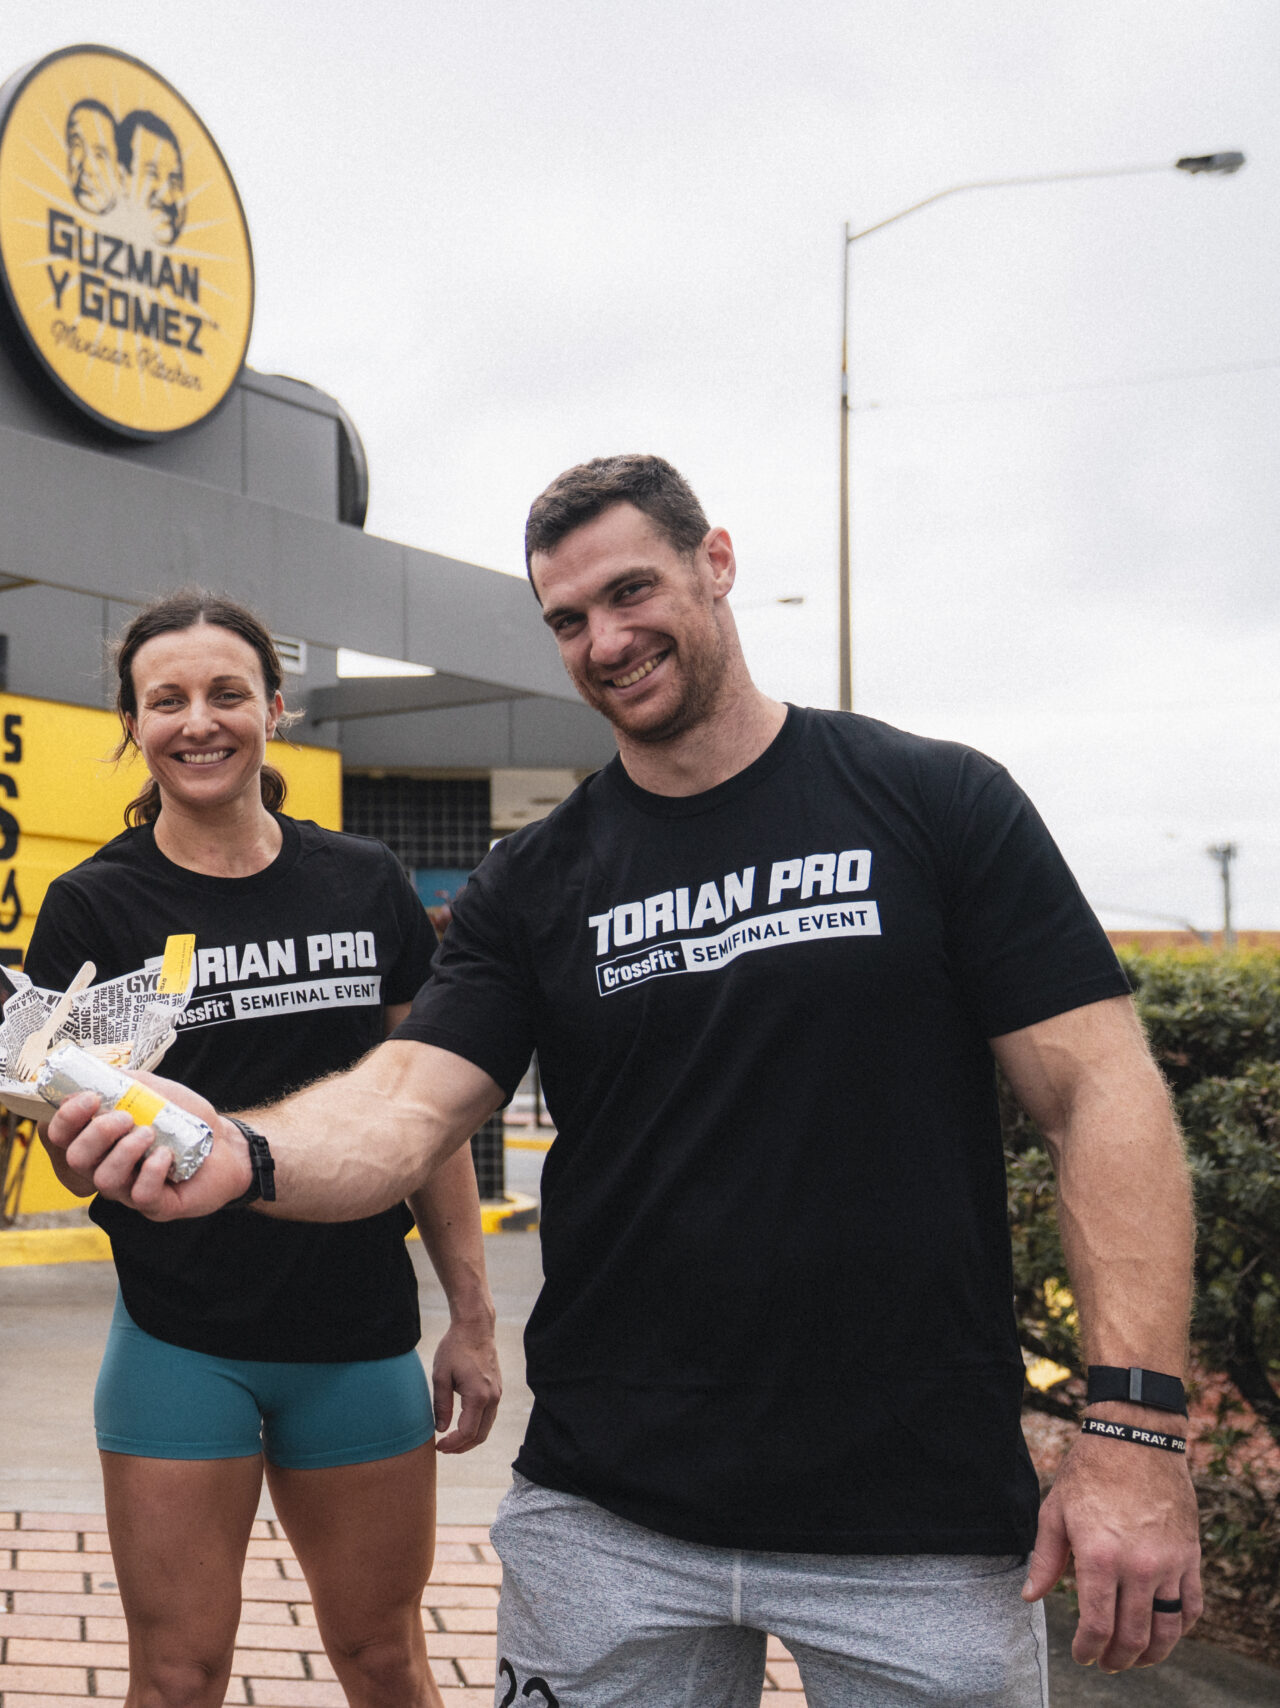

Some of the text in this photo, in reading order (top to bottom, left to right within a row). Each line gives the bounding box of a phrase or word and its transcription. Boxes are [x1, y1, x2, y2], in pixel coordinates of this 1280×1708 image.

[48, 208, 199, 303] GUZMAN
[47, 264, 203, 355] Y GOMEZ
[588, 849, 872, 956] TORIAN PRO
[307, 931, 377, 972] PRO
[603, 909, 868, 988] CrossFit SEMIFINAL EVENT
[81, 1006, 92, 1039] SONG:
[241, 987, 330, 1011] SEMIFINAL
[334, 983, 376, 1000] EVENT
[1090, 1421, 1125, 1437] PRAY.
[1132, 1430, 1167, 1446] PRAY.
